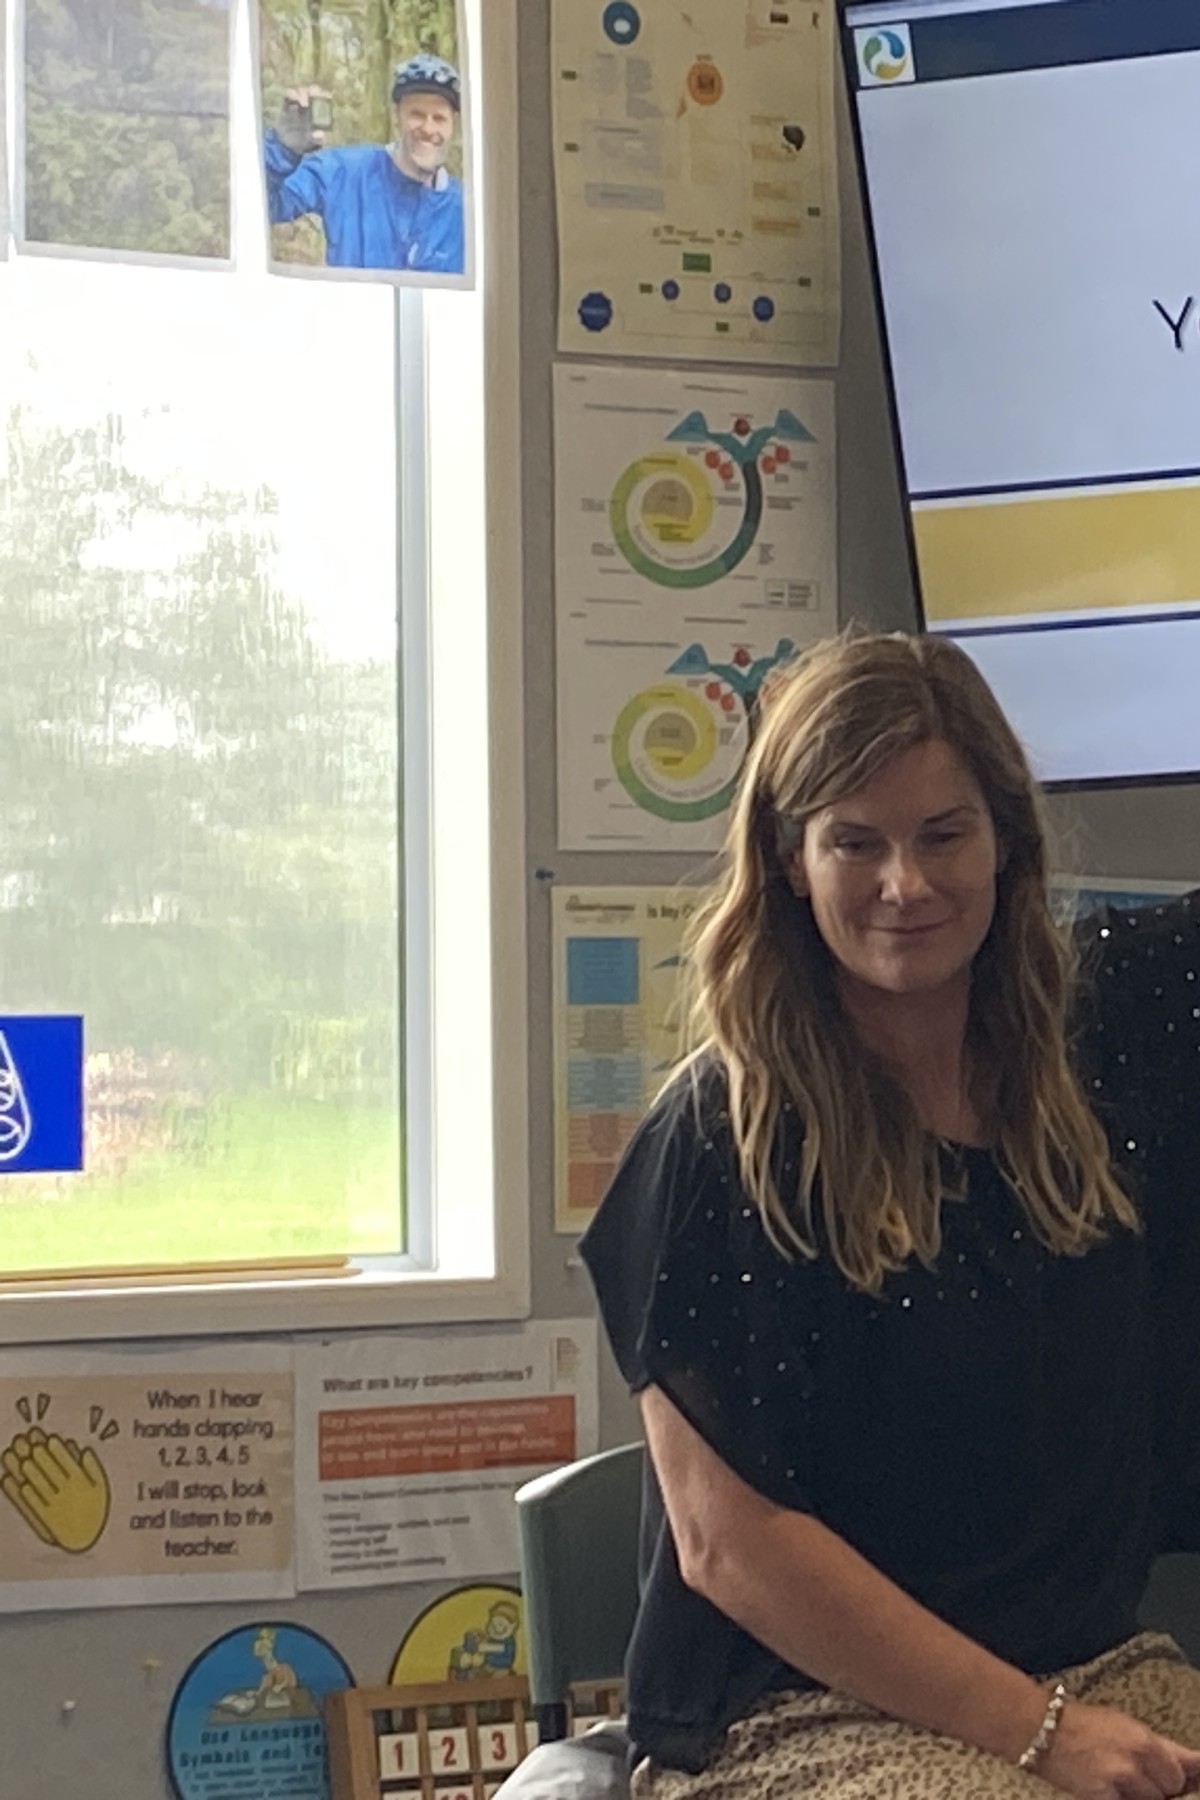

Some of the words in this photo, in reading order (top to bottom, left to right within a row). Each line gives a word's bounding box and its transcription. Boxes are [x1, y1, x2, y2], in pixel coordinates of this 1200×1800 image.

[147, 1389, 200, 1410] When
[208, 1388, 217, 1409] I
[221, 1388, 264, 1409] hear
[133, 1418, 191, 1438] hands
[194, 1417, 274, 1440] clapping
[237, 1444, 251, 1465] 5
[137, 1481, 145, 1501] I
[149, 1479, 180, 1500] will
[183, 1482, 228, 1503] stop,
[232, 1477, 268, 1499] look
[129, 1510, 167, 1530] and
[169, 1508, 220, 1529] listen
[223, 1508, 243, 1528] to
[245, 1507, 274, 1527] the
[393, 1739, 405, 1772] 1
[440, 1736, 457, 1767] 2
[491, 1731, 507, 1762] 3
